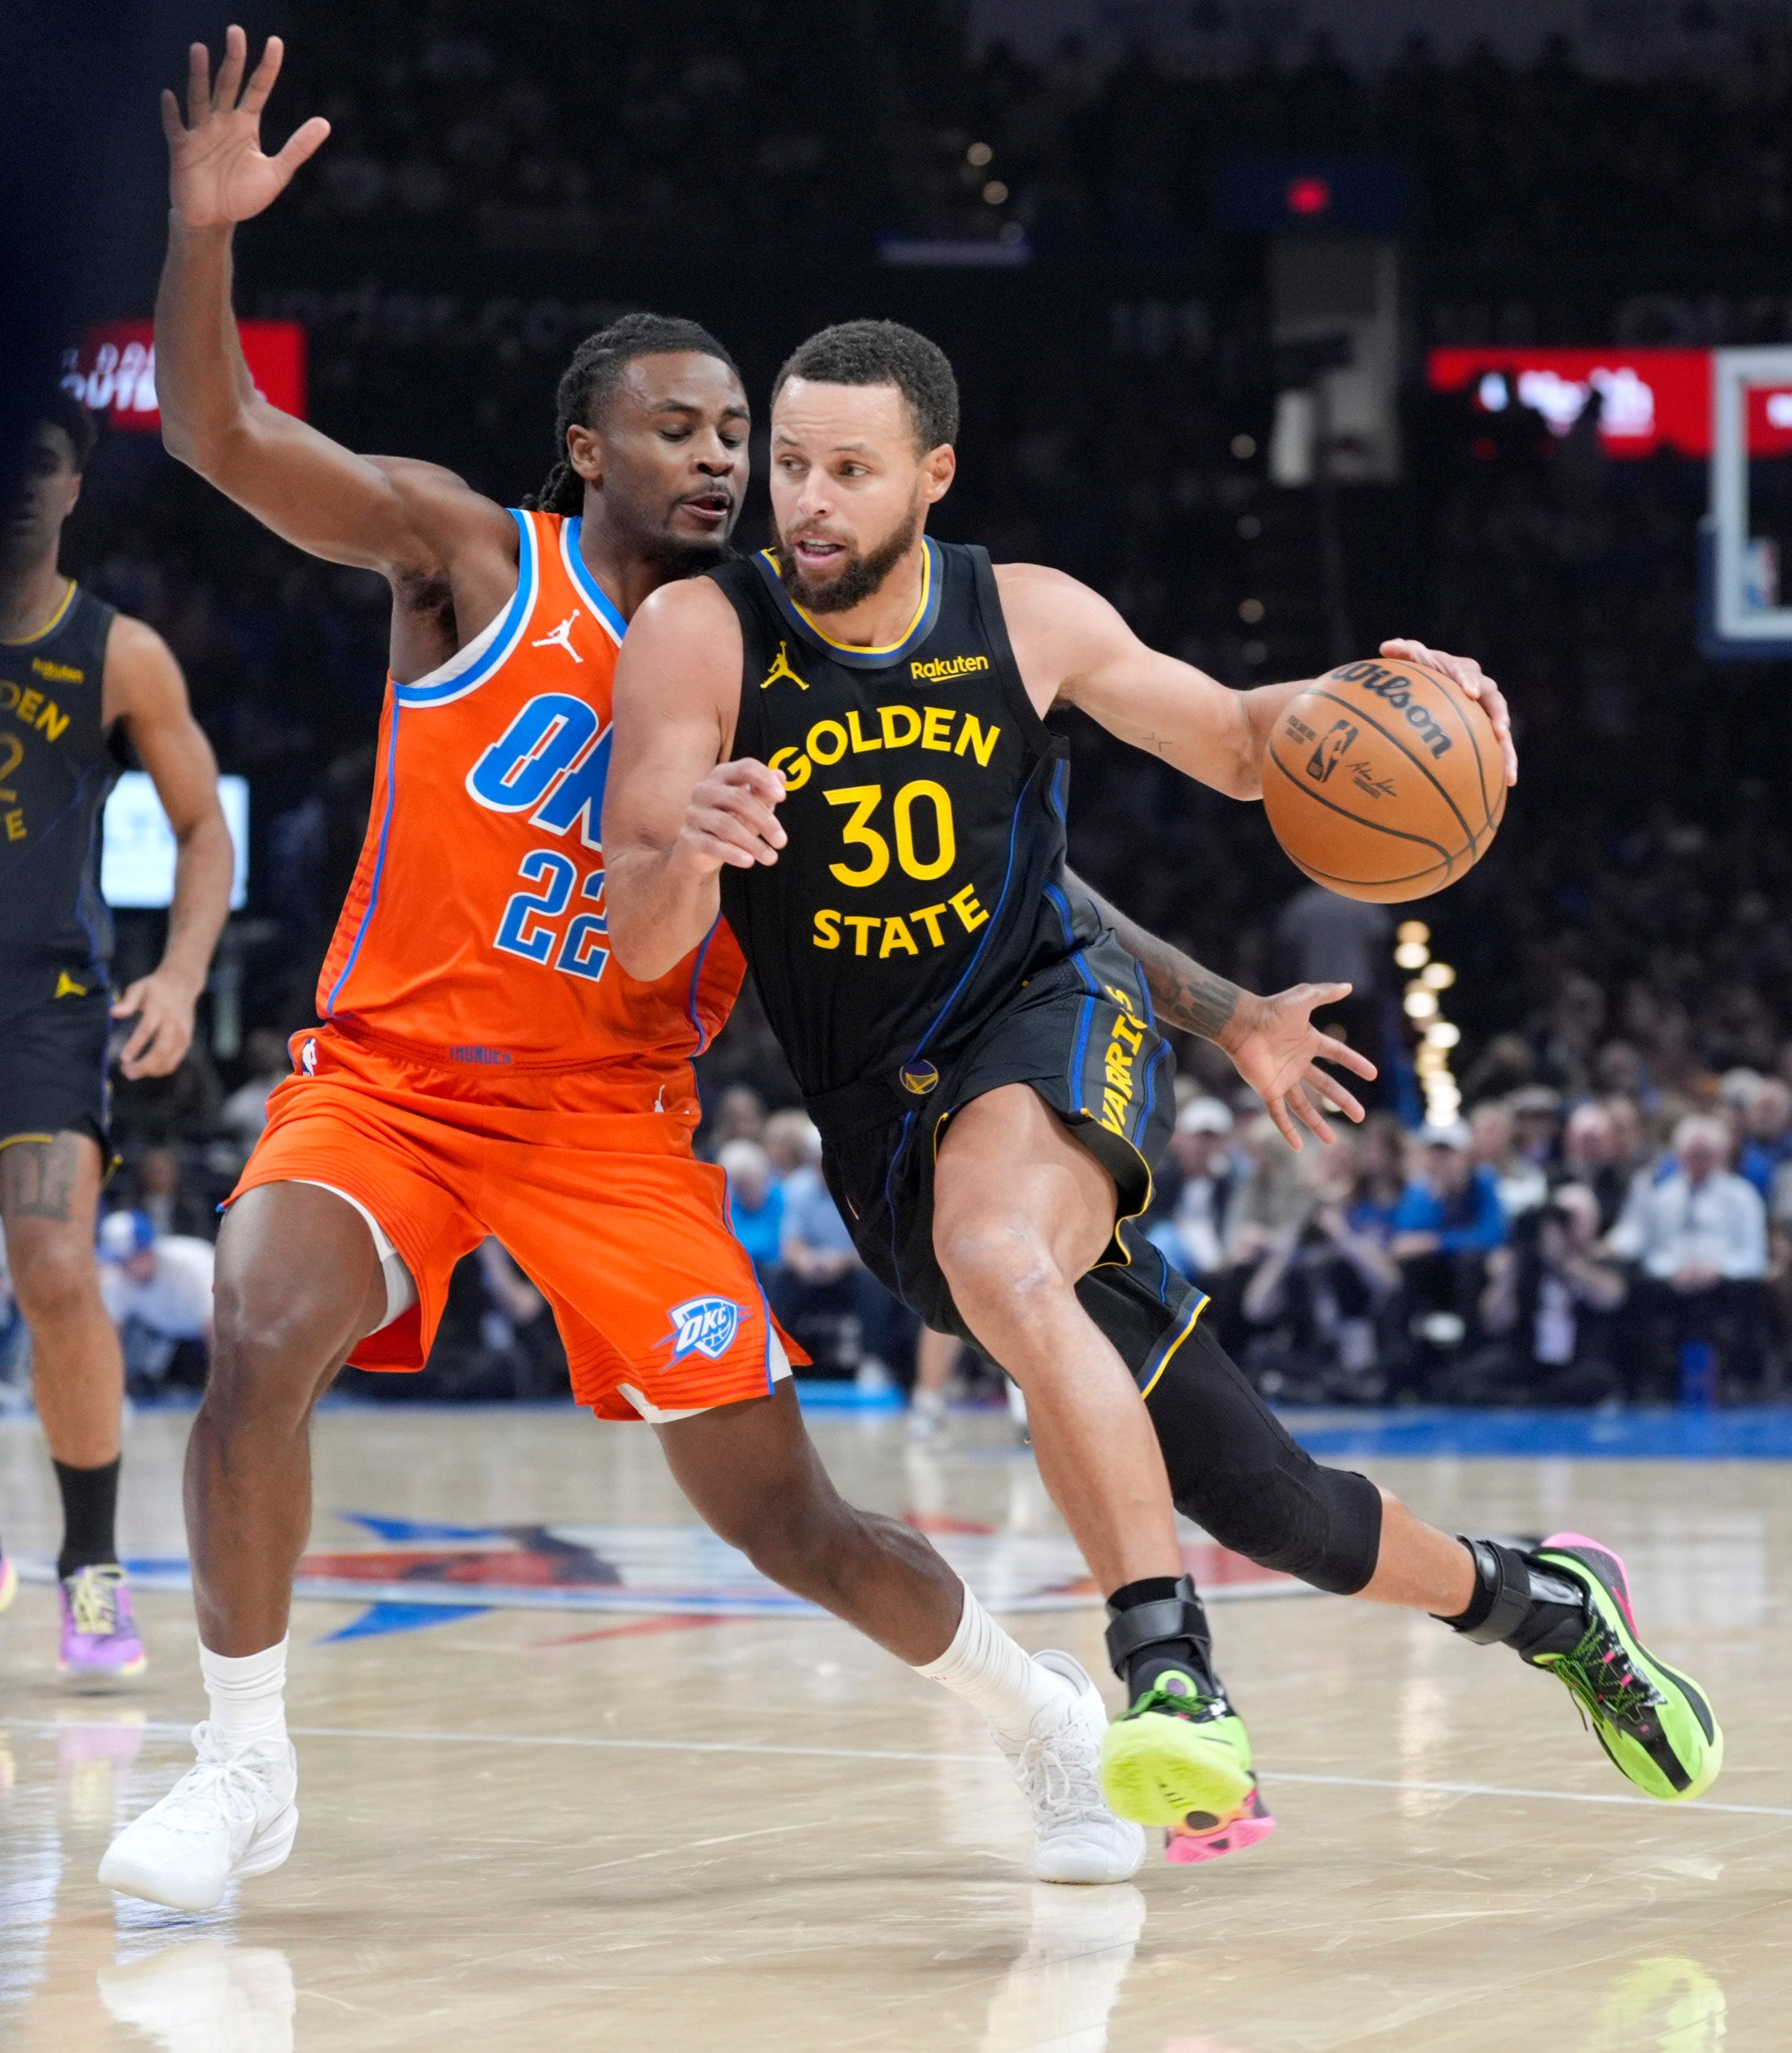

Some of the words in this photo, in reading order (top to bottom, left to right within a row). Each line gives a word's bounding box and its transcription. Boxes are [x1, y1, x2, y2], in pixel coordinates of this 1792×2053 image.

[910, 655, 989, 681] Rakuten
[1330, 662, 1453, 760] Wilson
[768, 705, 1001, 791] GOLDEN
[823, 780, 956, 887] 30
[493, 849, 611, 982] 22
[813, 884, 989, 958] STATE
[676, 1305, 727, 1352] OKC
